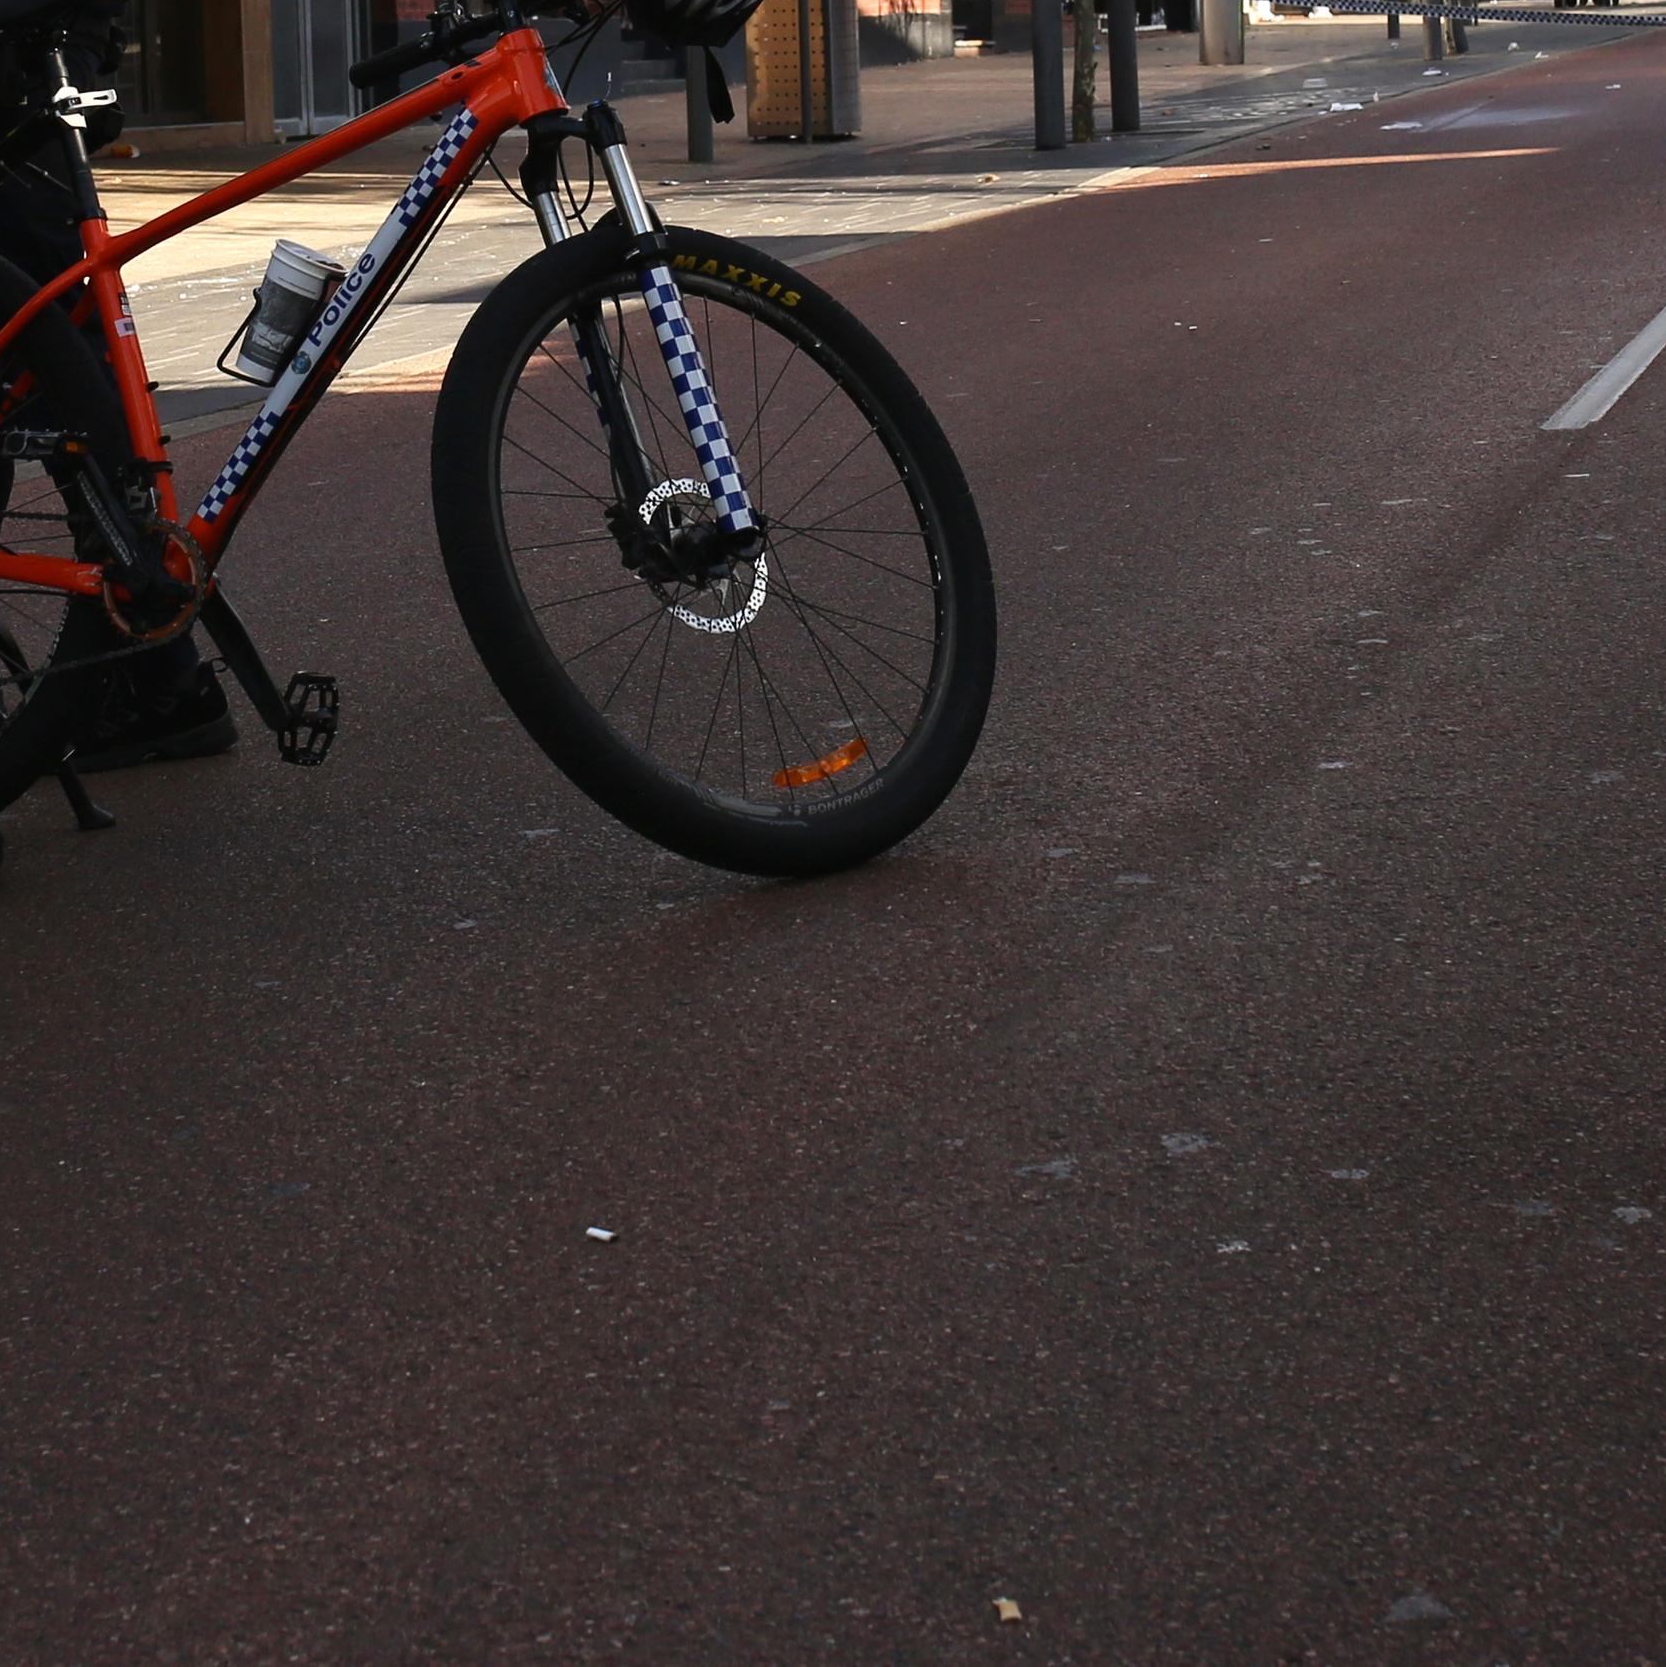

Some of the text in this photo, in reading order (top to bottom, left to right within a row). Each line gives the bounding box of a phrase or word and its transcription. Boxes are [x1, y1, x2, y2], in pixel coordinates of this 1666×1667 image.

[307, 253, 376, 348] Police
[672, 254, 802, 307] MAXXIS
[808, 777, 885, 815] BONTRAGER
